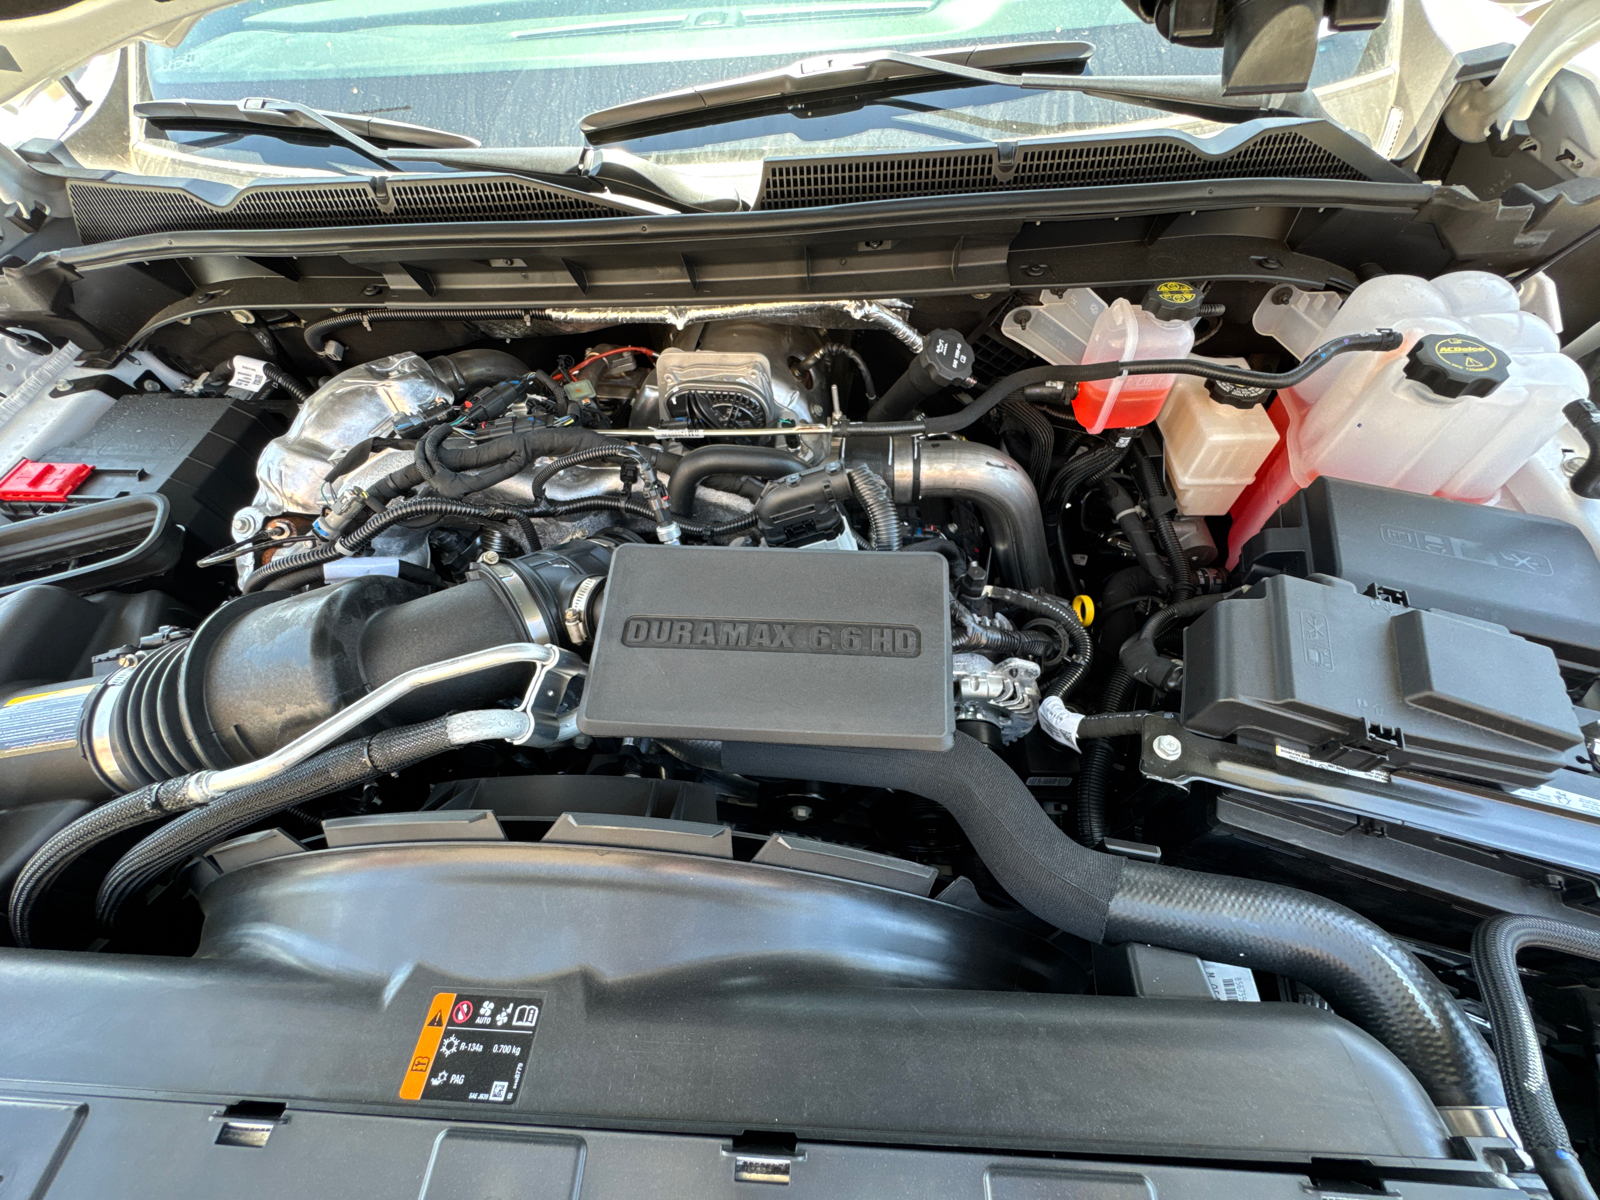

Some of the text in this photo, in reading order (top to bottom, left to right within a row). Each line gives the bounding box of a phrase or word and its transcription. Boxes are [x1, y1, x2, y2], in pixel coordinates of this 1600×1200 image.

[627, 619, 918, 654] DURAMAX 6.6 HD
[459, 1042, 521, 1056] R-134a 0.700 kg
[449, 1074, 465, 1085] PAG
